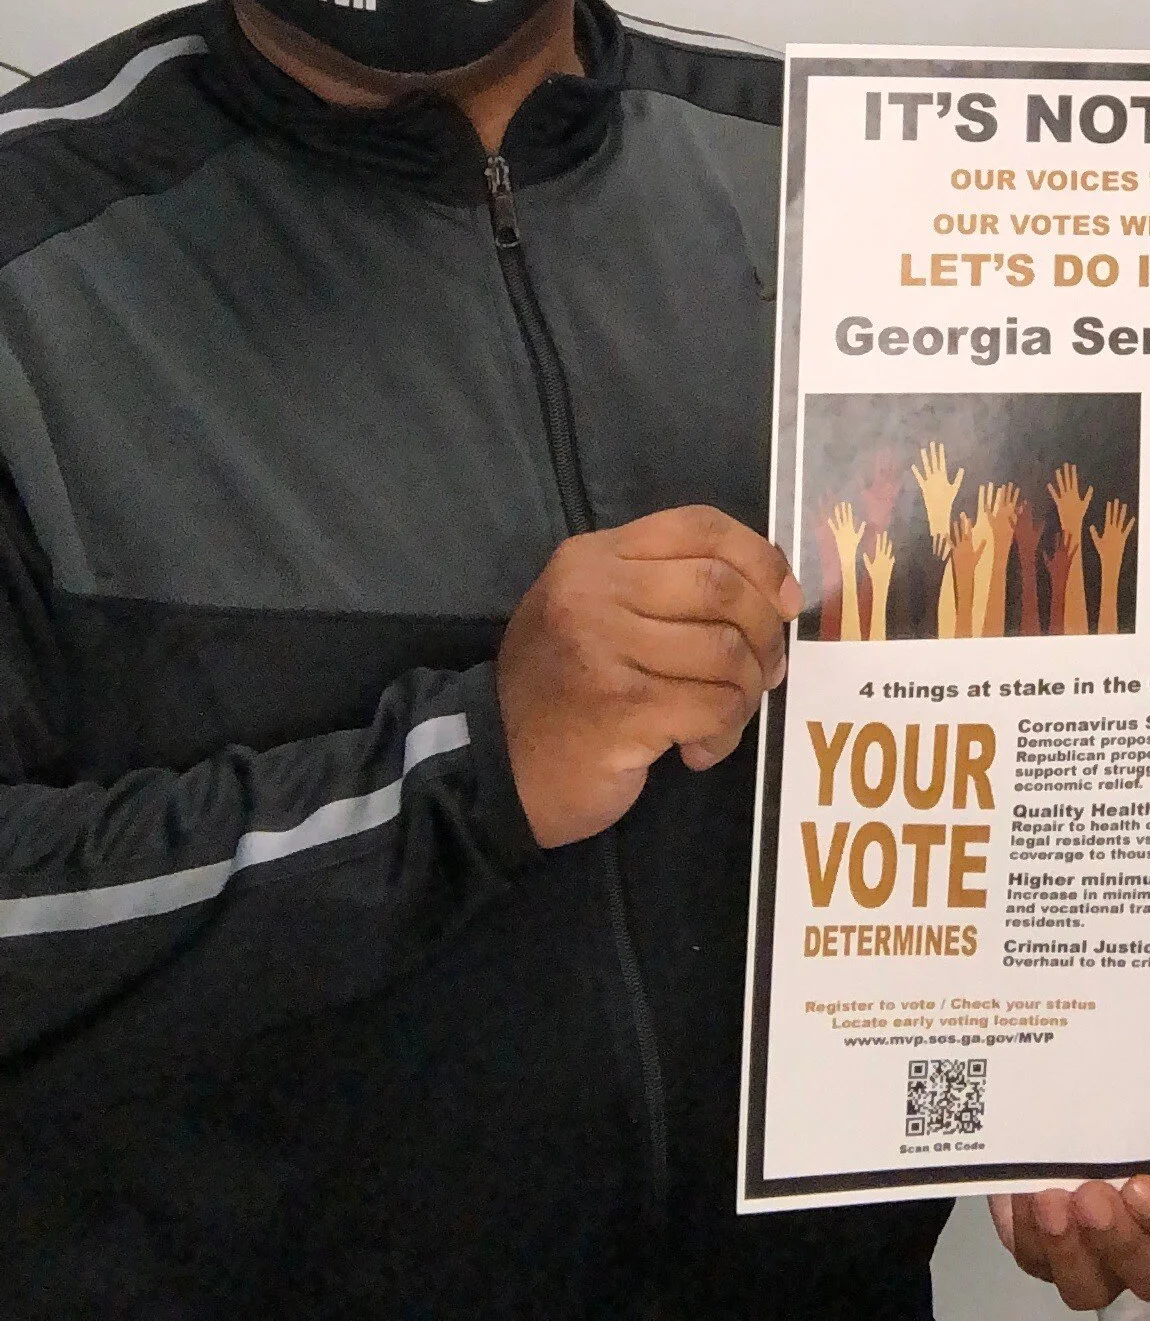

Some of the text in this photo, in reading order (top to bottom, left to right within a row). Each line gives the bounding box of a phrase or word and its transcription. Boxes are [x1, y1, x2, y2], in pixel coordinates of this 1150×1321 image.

[864, 91, 998, 142] IT'S
[951, 169, 1016, 191] OUR
[1026, 170, 1139, 192] VOICES
[933, 214, 999, 235] OUR
[1010, 214, 1110, 236] VOTES
[901, 254, 1034, 286] LET'S
[1053, 254, 1119, 288] DO
[836, 316, 1051, 365] Georgia
[859, 681, 874, 698] 4
[882, 679, 959, 703] things
[968, 677, 992, 696] at
[1000, 679, 1065, 696] stake
[1074, 678, 1094, 694] in
[1103, 677, 1141, 694] the
[1019, 717, 1138, 733] Coronavirus
[1017, 736, 1095, 748] Democrat
[806, 721, 996, 810] YOUR
[1017, 751, 1105, 764] Republican
[1016, 765, 1077, 779] support
[1083, 764, 1098, 775] of
[1013, 804, 1084, 821] Quality
[801, 821, 990, 909] VOTE
[1008, 873, 1075, 889] Higher
[1007, 889, 1077, 900] Increase
[1083, 889, 1097, 899] in
[1006, 917, 1085, 927] residents.
[804, 925, 978, 958] DETERMINES
[1004, 940, 1087, 953] Criminal
[805, 1000, 873, 1014] Register
[880, 1000, 894, 1010] to
[901, 1000, 936, 1010] vote
[950, 998, 1000, 1010] Check
[1006, 1000, 1040, 1012] your
[1046, 998, 1096, 1010] status
[844, 1032, 1054, 1047] www.mvp.sos.ga.gov/MVP
